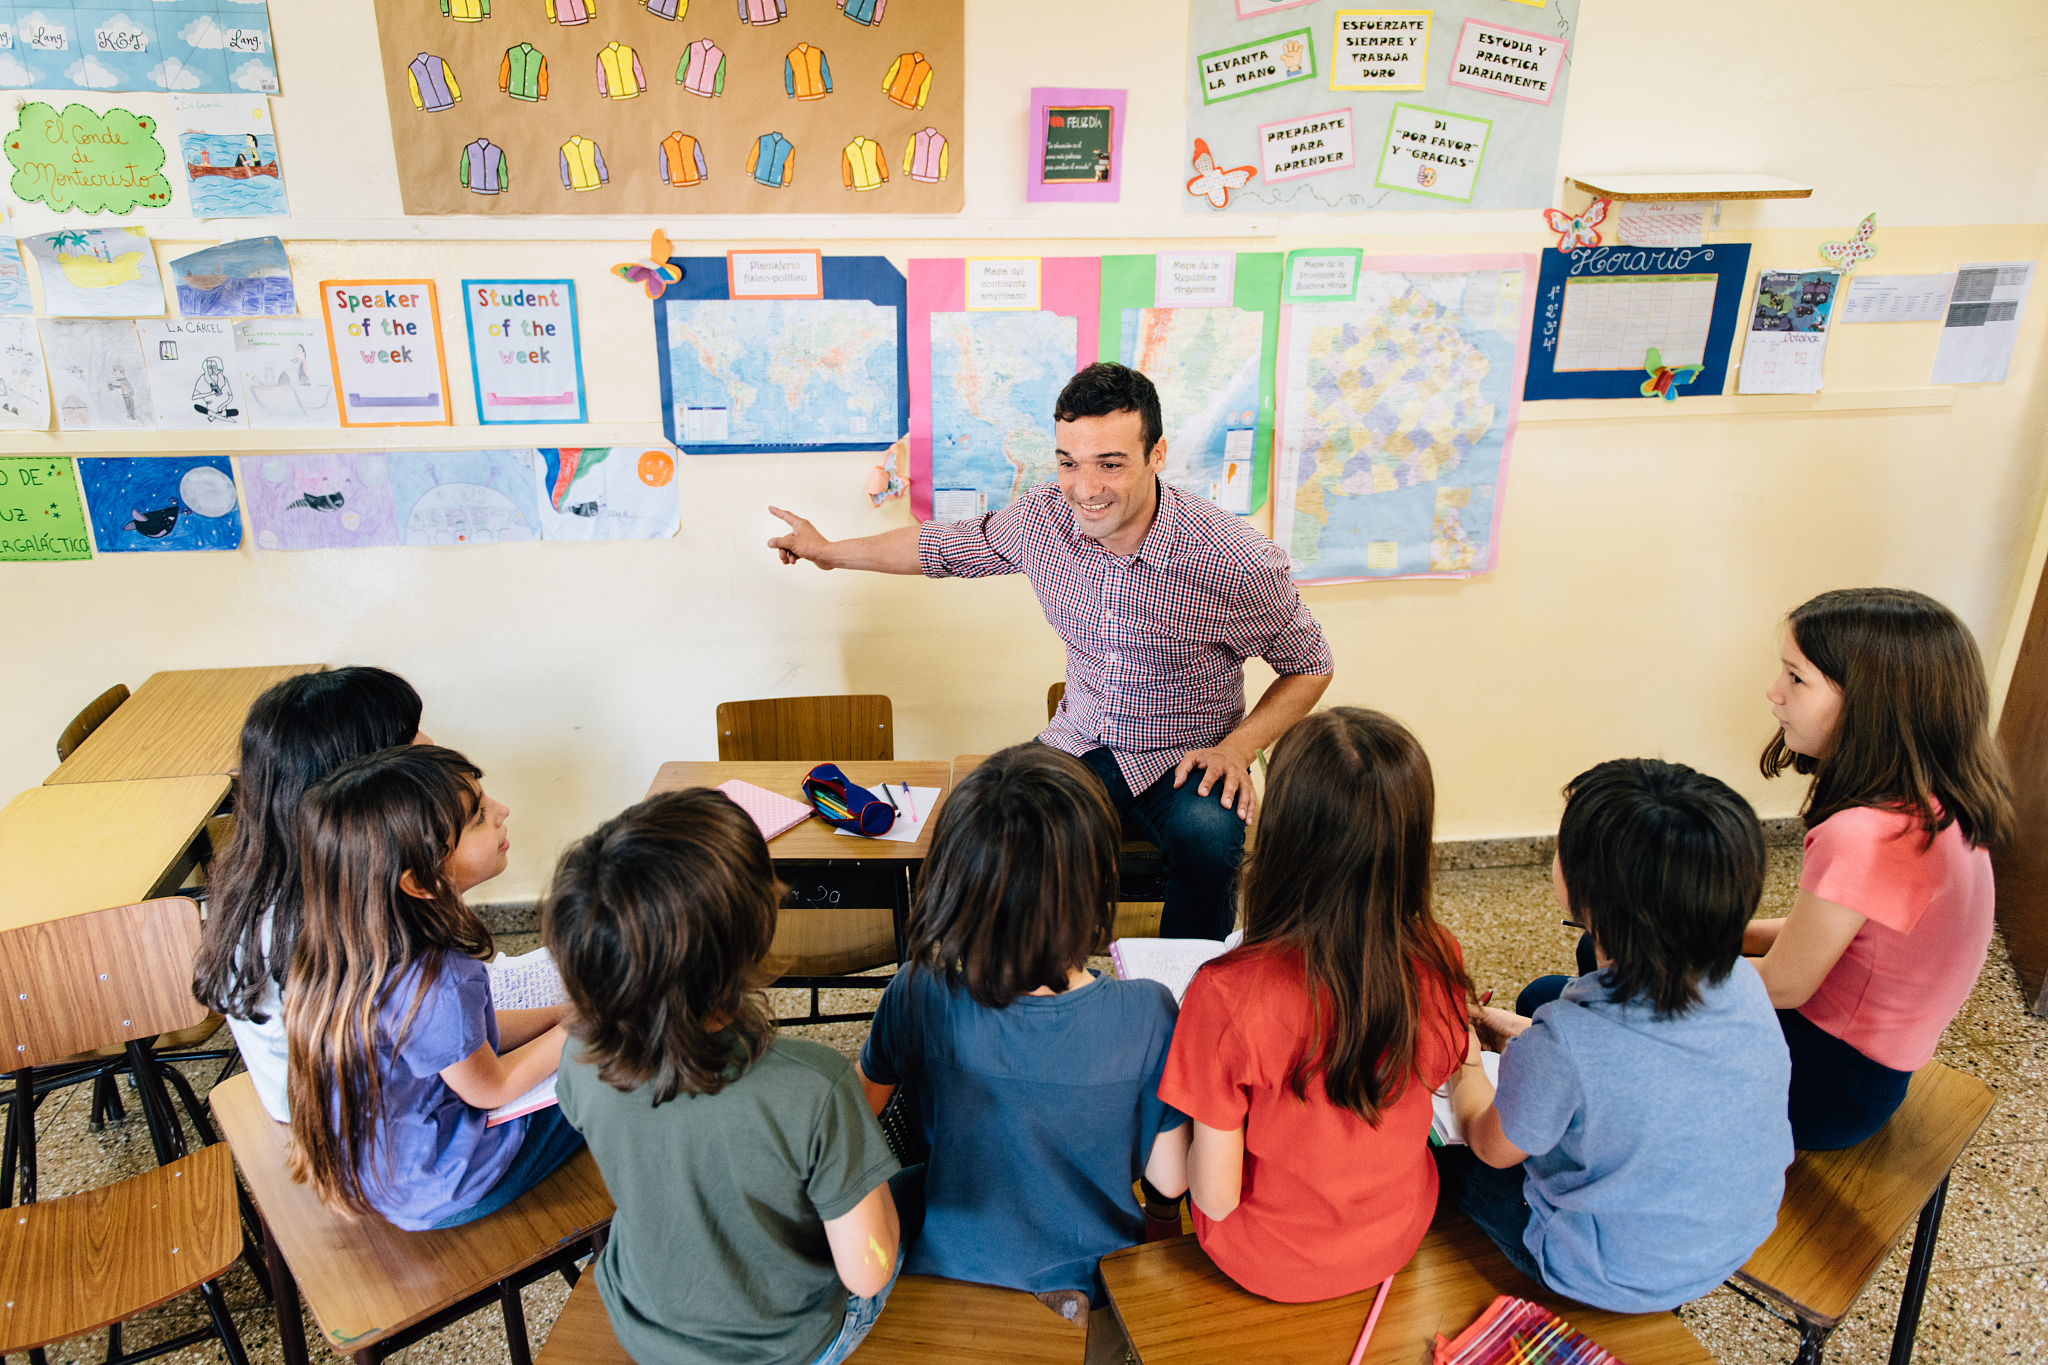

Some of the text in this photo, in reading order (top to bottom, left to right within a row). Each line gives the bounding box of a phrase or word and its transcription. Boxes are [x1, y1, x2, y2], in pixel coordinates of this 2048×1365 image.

[1342, 18, 1424, 32] ESFUÉRZATE
[32, 26, 66, 50] Lang.
[230, 30, 262, 51] Lang.
[1346, 36, 1418, 46] SIEMPRE Y
[1478, 33, 1546, 57] ESTUDIA Y
[1206, 50, 1269, 74] LEVANTA
[1352, 52, 1409, 62] TRABAJA
[1476, 49, 1539, 72] PRACTICA
[1209, 65, 1276, 90] LA MANO
[1363, 68, 1396, 78] DURO
[1458, 63, 1548, 92] DIARIAMENTE
[46, 120, 129, 145] El Conde
[1266, 118, 1346, 142] PREPÁRATE
[1434, 120, 1447, 130] DI
[1290, 139, 1325, 154] PARA
[1391, 145, 1400, 155] Y
[72, 148, 94, 164] de
[1274, 152, 1344, 174] APRENDER
[23, 162, 160, 202] Montecristo
[750, 261, 800, 272] Planisferio
[1172, 261, 1220, 270] Mapa de la
[1304, 260, 1344, 269] Mapa de la
[1571, 247, 1714, 275] Horario
[744, 274, 808, 284] físico-político
[984, 267, 1024, 277] Mapa del
[1174, 272, 1218, 283] República
[1299, 272, 1336, 280] Provincia
[980, 280, 1027, 288] continente
[1173, 286, 1216, 296] Argentina
[1296, 282, 1347, 290] Buenos Aires
[336, 290, 420, 312] Speaker
[478, 289, 560, 308] Student
[980, 292, 1027, 300] americano
[166, 320, 223, 334] LA CÁRCEL
[348, 318, 417, 337] of the
[489, 318, 556, 338] of the
[1784, 332, 1820, 343] October
[360, 346, 414, 364] week
[499, 346, 551, 364] week
[19, 468, 44, 486] DE
[0, 532, 88, 553] RGALÁCTICO
